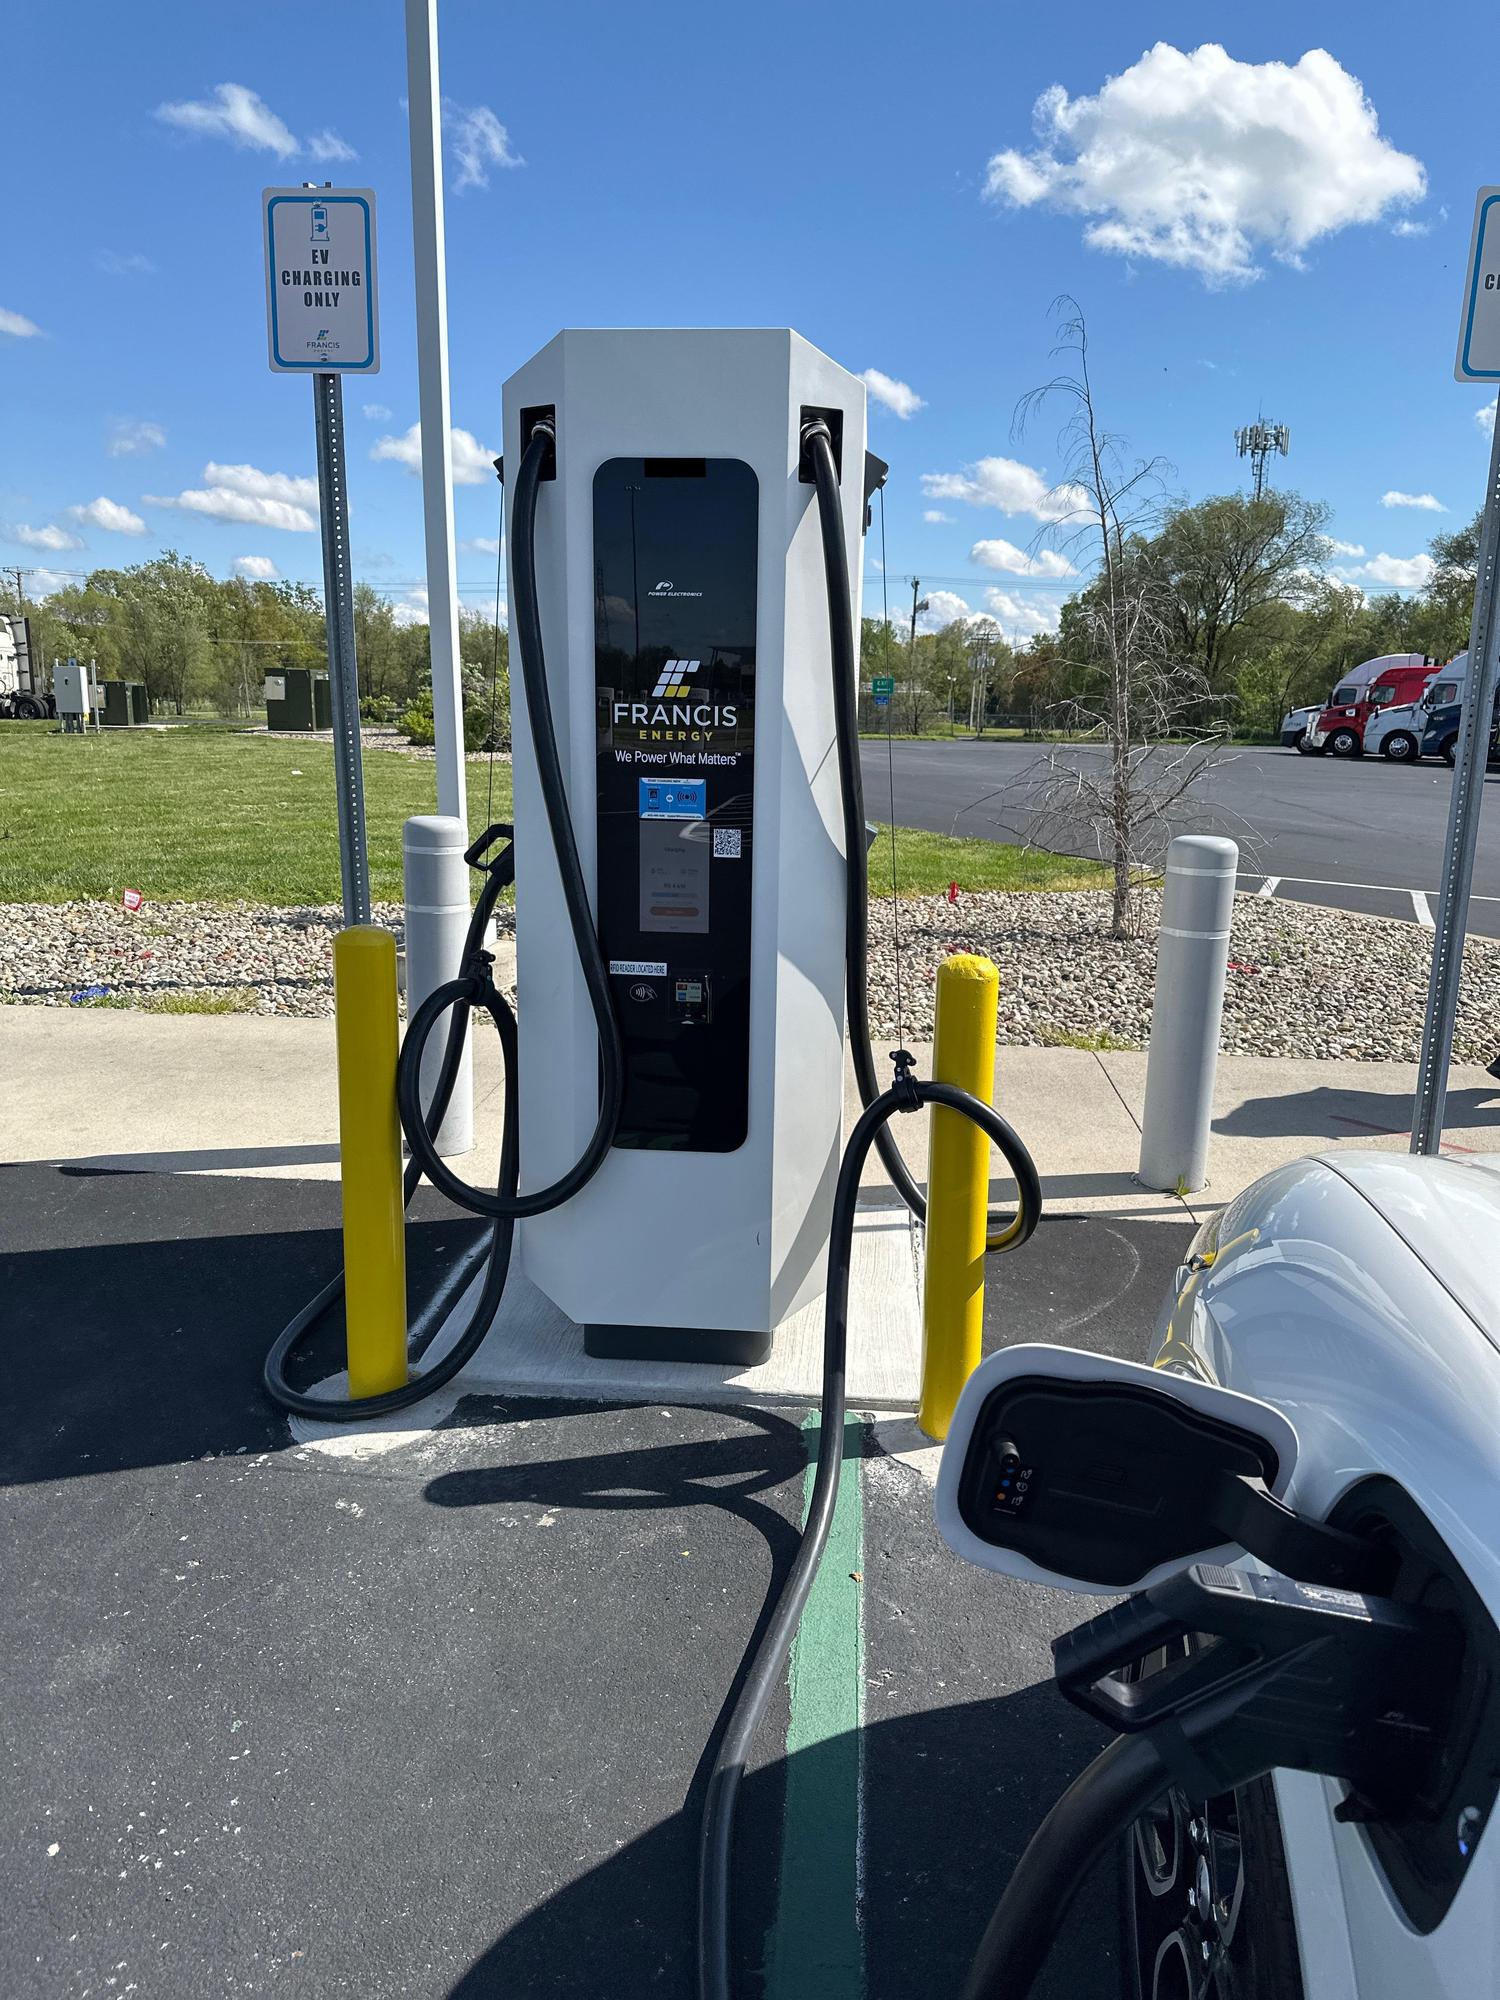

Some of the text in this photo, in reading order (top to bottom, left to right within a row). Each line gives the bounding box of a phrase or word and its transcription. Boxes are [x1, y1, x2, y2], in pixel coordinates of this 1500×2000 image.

[311, 249, 330, 264] EV
[281, 270, 361, 287] CHARGING
[1485, 274, 1500, 290] C
[303, 292, 341, 308] ONLY
[306, 341, 341, 349] FRANCIS
[614, 703, 738, 727] FRANCIS
[639, 729, 714, 742] ENERGY
[614, 750, 632, 763] We
[634, 750, 668, 764] Power
[669, 751, 696, 765] What
[620, 963, 635, 973] READER
[635, 964, 653, 974] LOCATED
[653, 965, 665, 974] HERE
